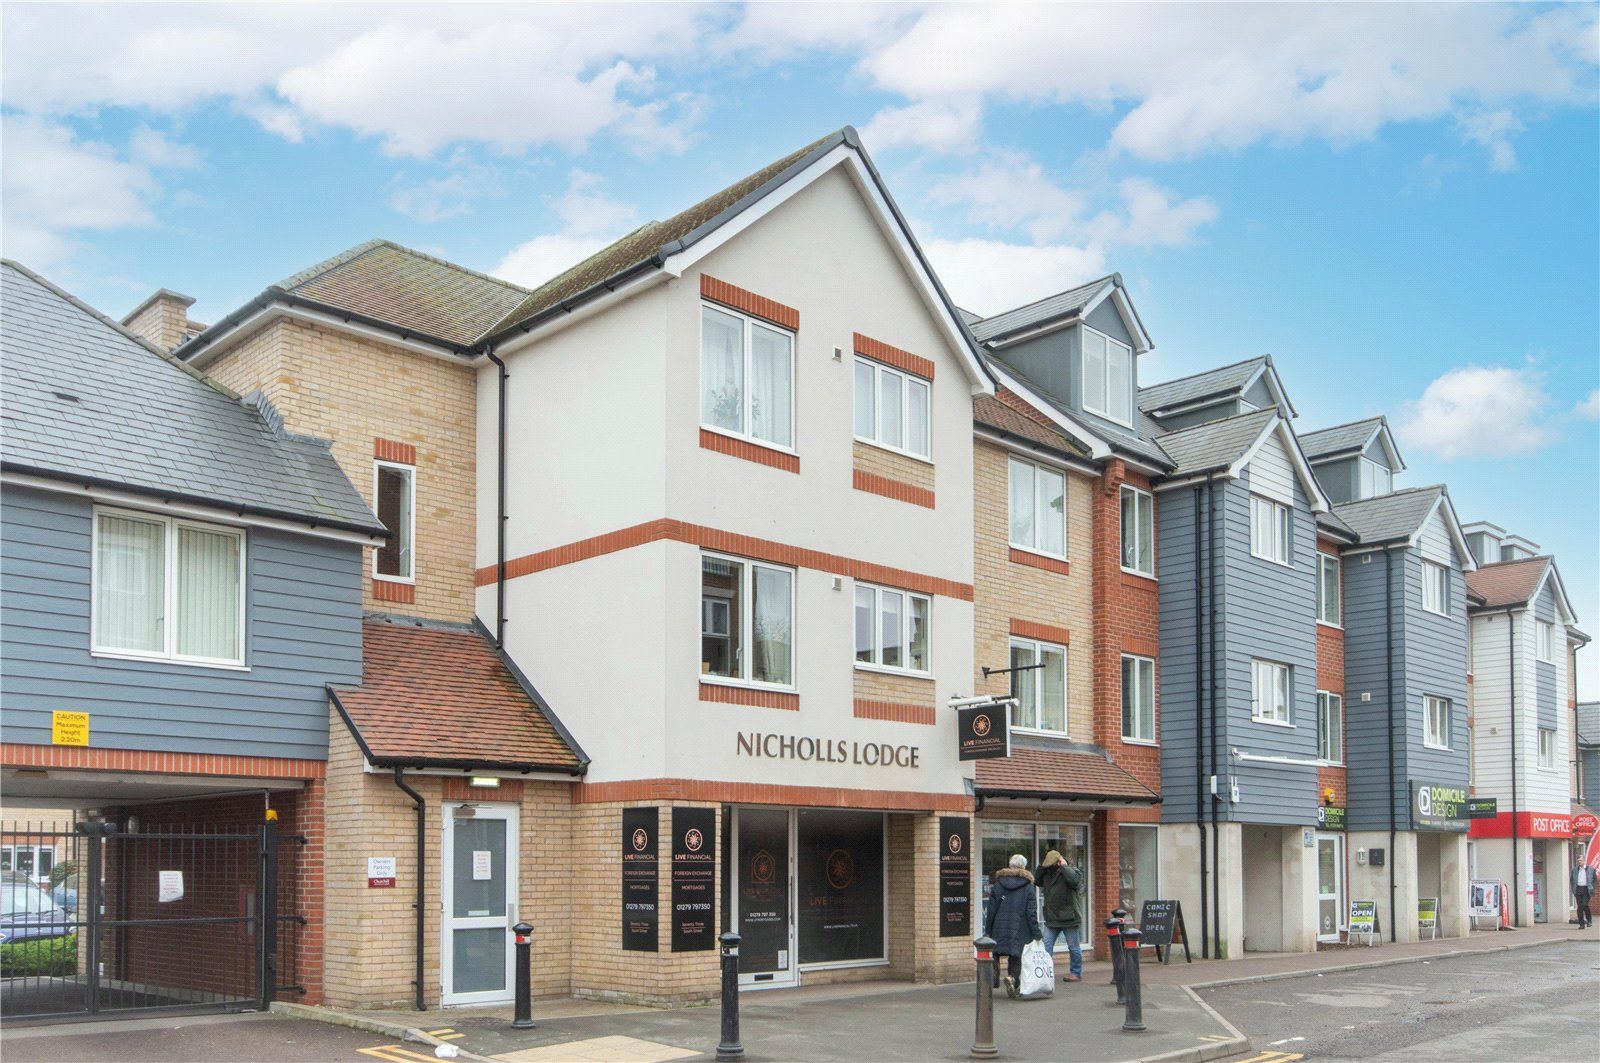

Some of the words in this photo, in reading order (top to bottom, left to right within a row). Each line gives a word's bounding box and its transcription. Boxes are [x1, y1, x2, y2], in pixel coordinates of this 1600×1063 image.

[736, 731, 848, 763] NICHOLLS
[853, 742, 919, 768] LODGE
[1432, 788, 1466, 804] DOMICILE
[1325, 807, 1344, 816] DOMICILE
[1432, 803, 1456, 817] DESIGN
[1534, 818, 1548, 831] POST
[1550, 820, 1570, 832] OFFICE
[1035, 967, 1053, 978] ONE
